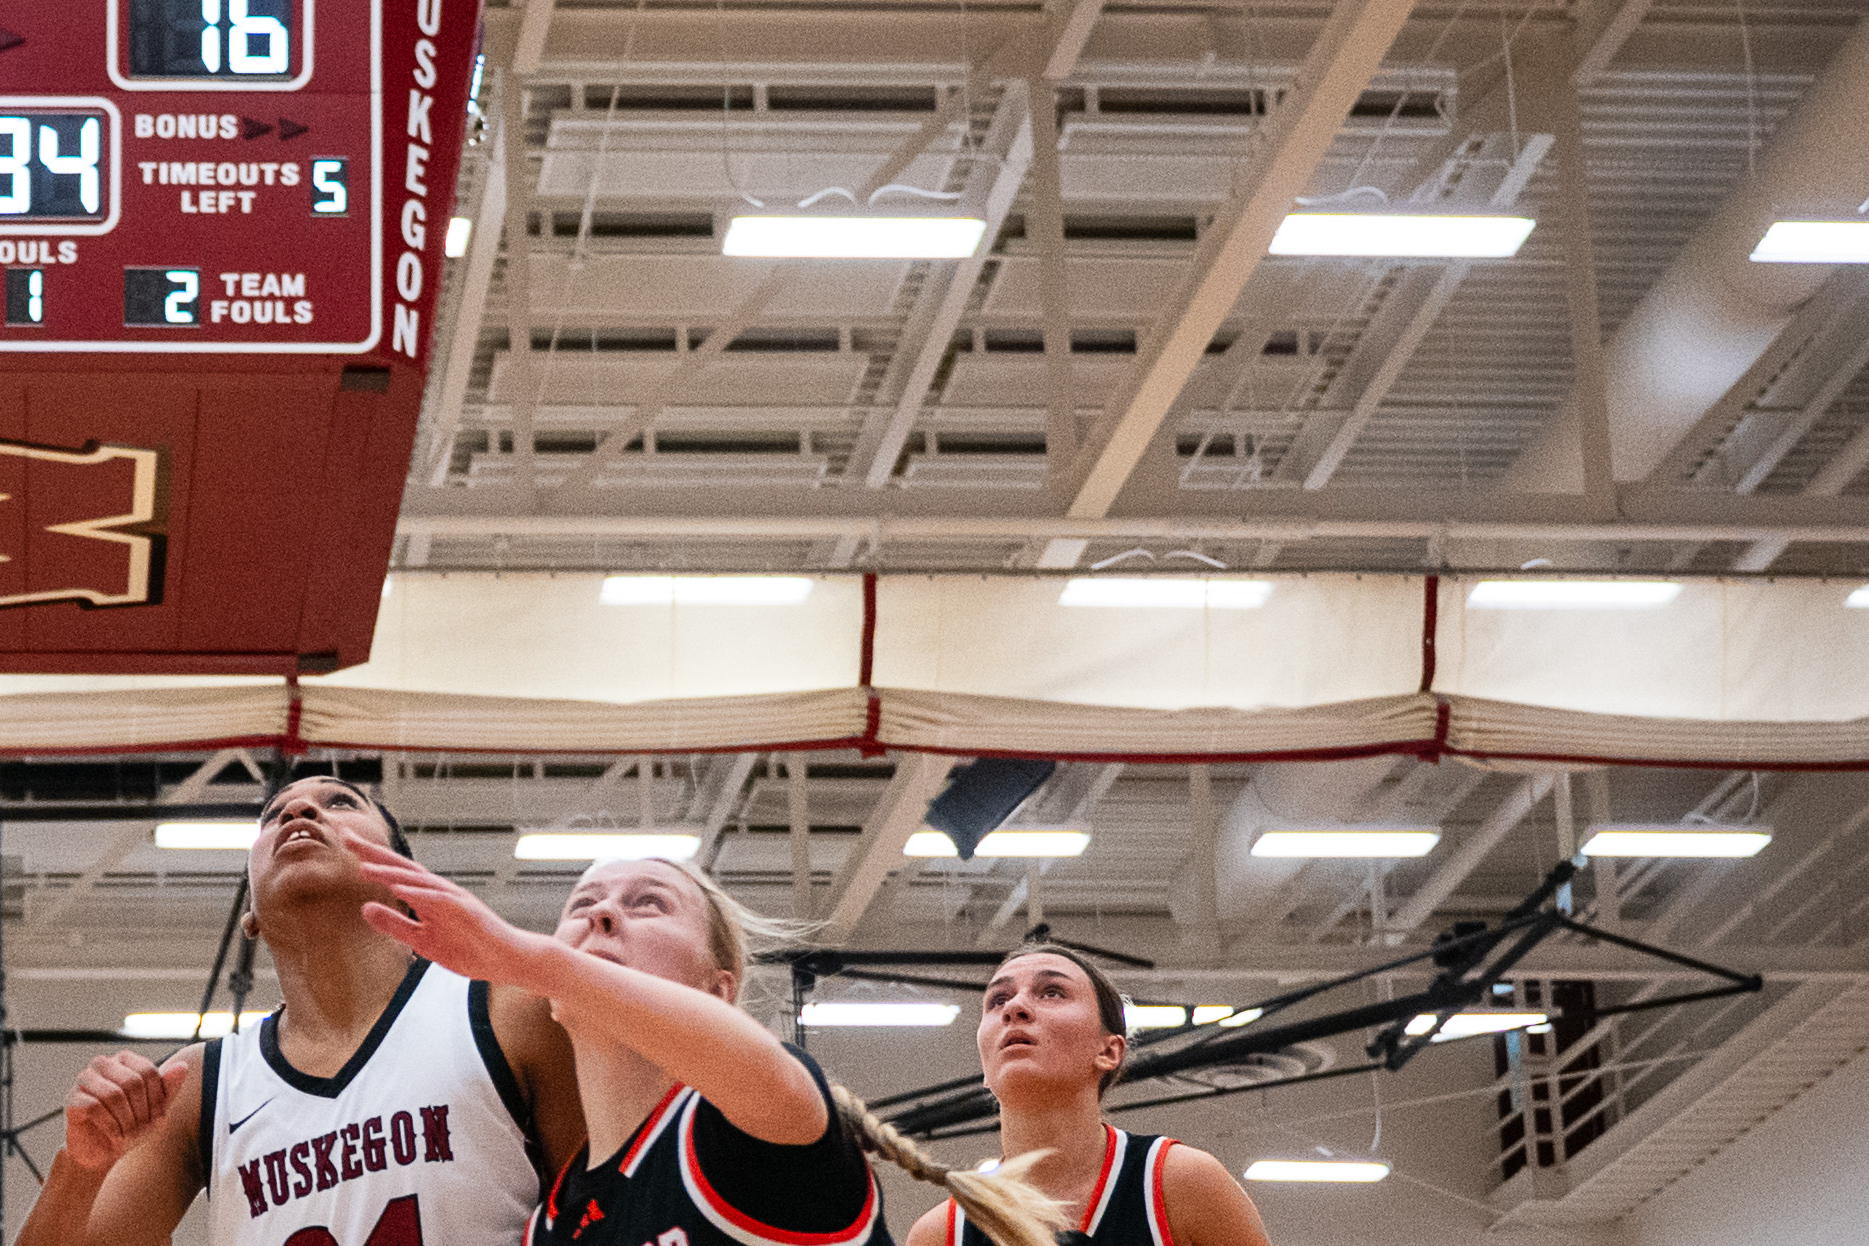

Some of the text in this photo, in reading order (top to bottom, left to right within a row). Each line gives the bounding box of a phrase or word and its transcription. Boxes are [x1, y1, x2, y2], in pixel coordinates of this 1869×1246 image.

[201, 0, 289, 74] 16
[134, 114, 239, 139] BONUS
[138, 162, 300, 185] TIMEOUTS
[312, 160, 347, 213] 5
[181, 191, 256, 213] LEFT
[29, 270, 43, 322] 1
[164, 271, 199, 323] 2
[220, 274, 305, 297] TEAM
[211, 301, 313, 324] FOULS
[238, 1105, 454, 1219] MUSKEGON
